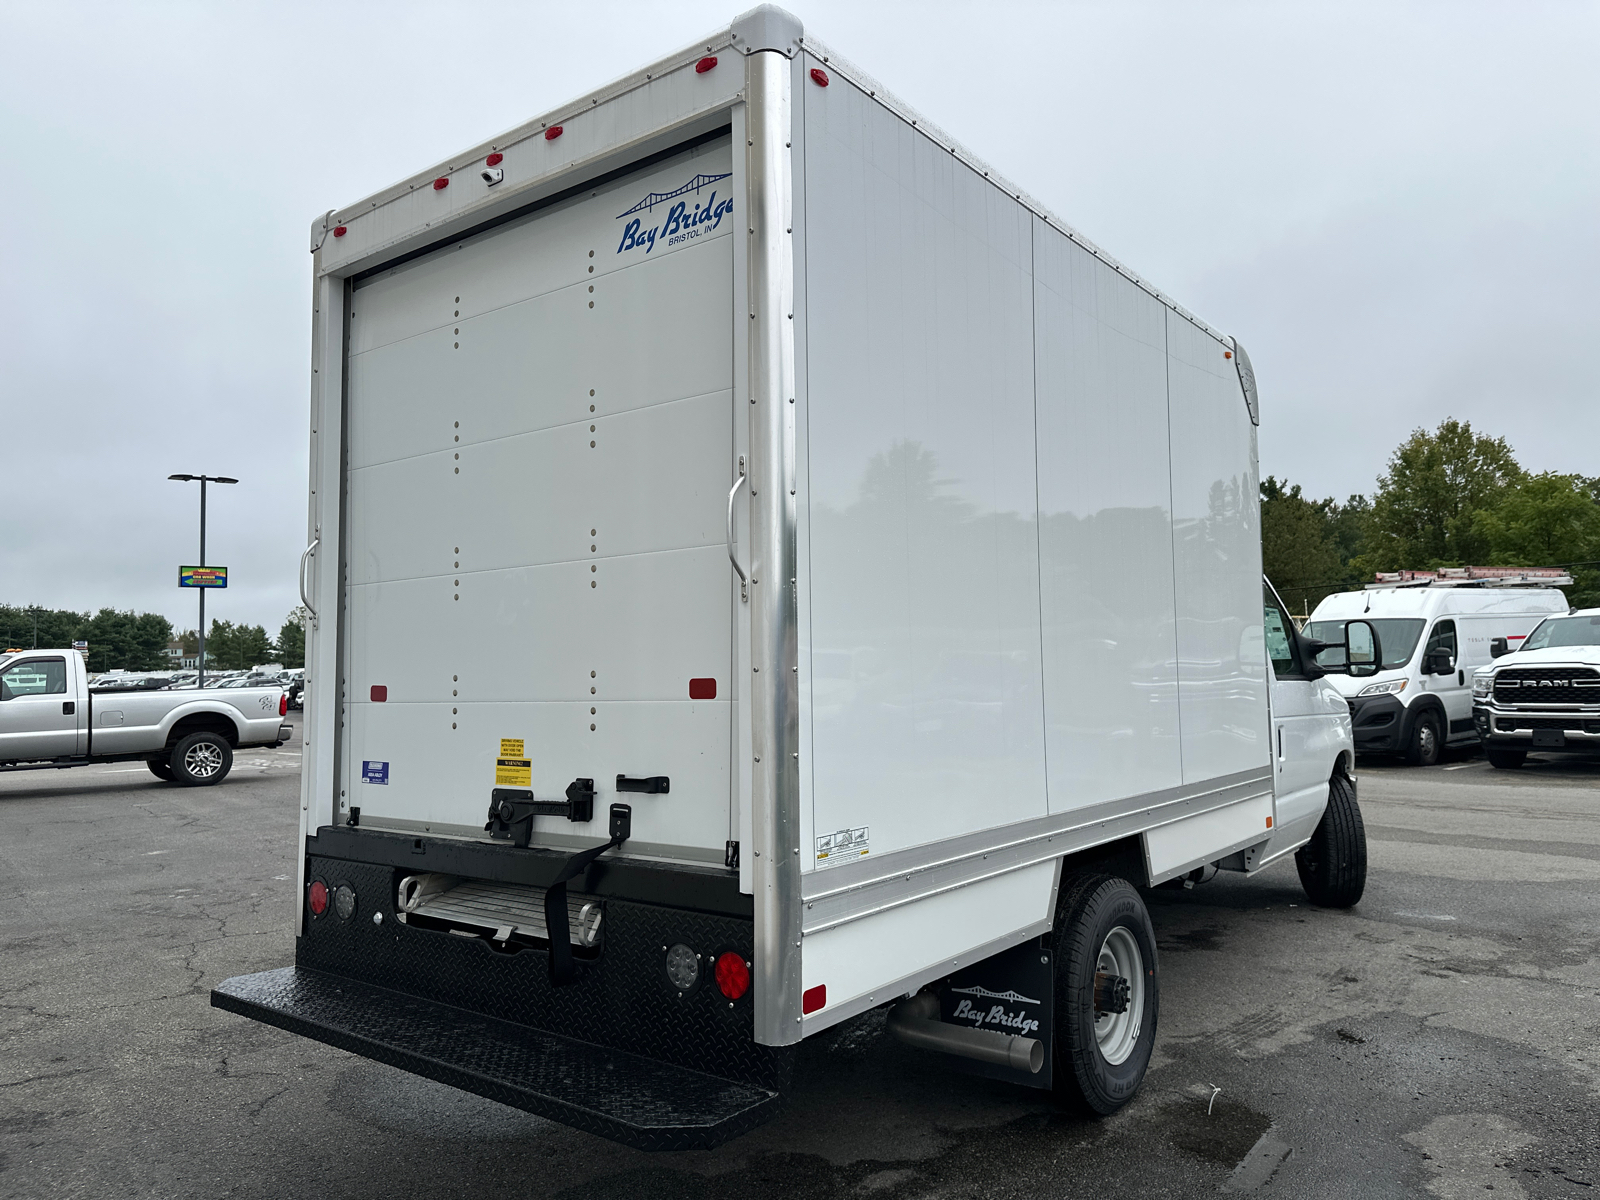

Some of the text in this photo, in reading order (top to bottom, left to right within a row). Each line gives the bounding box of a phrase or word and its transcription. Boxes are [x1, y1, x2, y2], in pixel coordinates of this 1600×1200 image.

[617, 190, 733, 254] Bay Bridge
[668, 224, 713, 246] BRISTOL, IN
[953, 999, 1039, 1035] Bay Bridge
